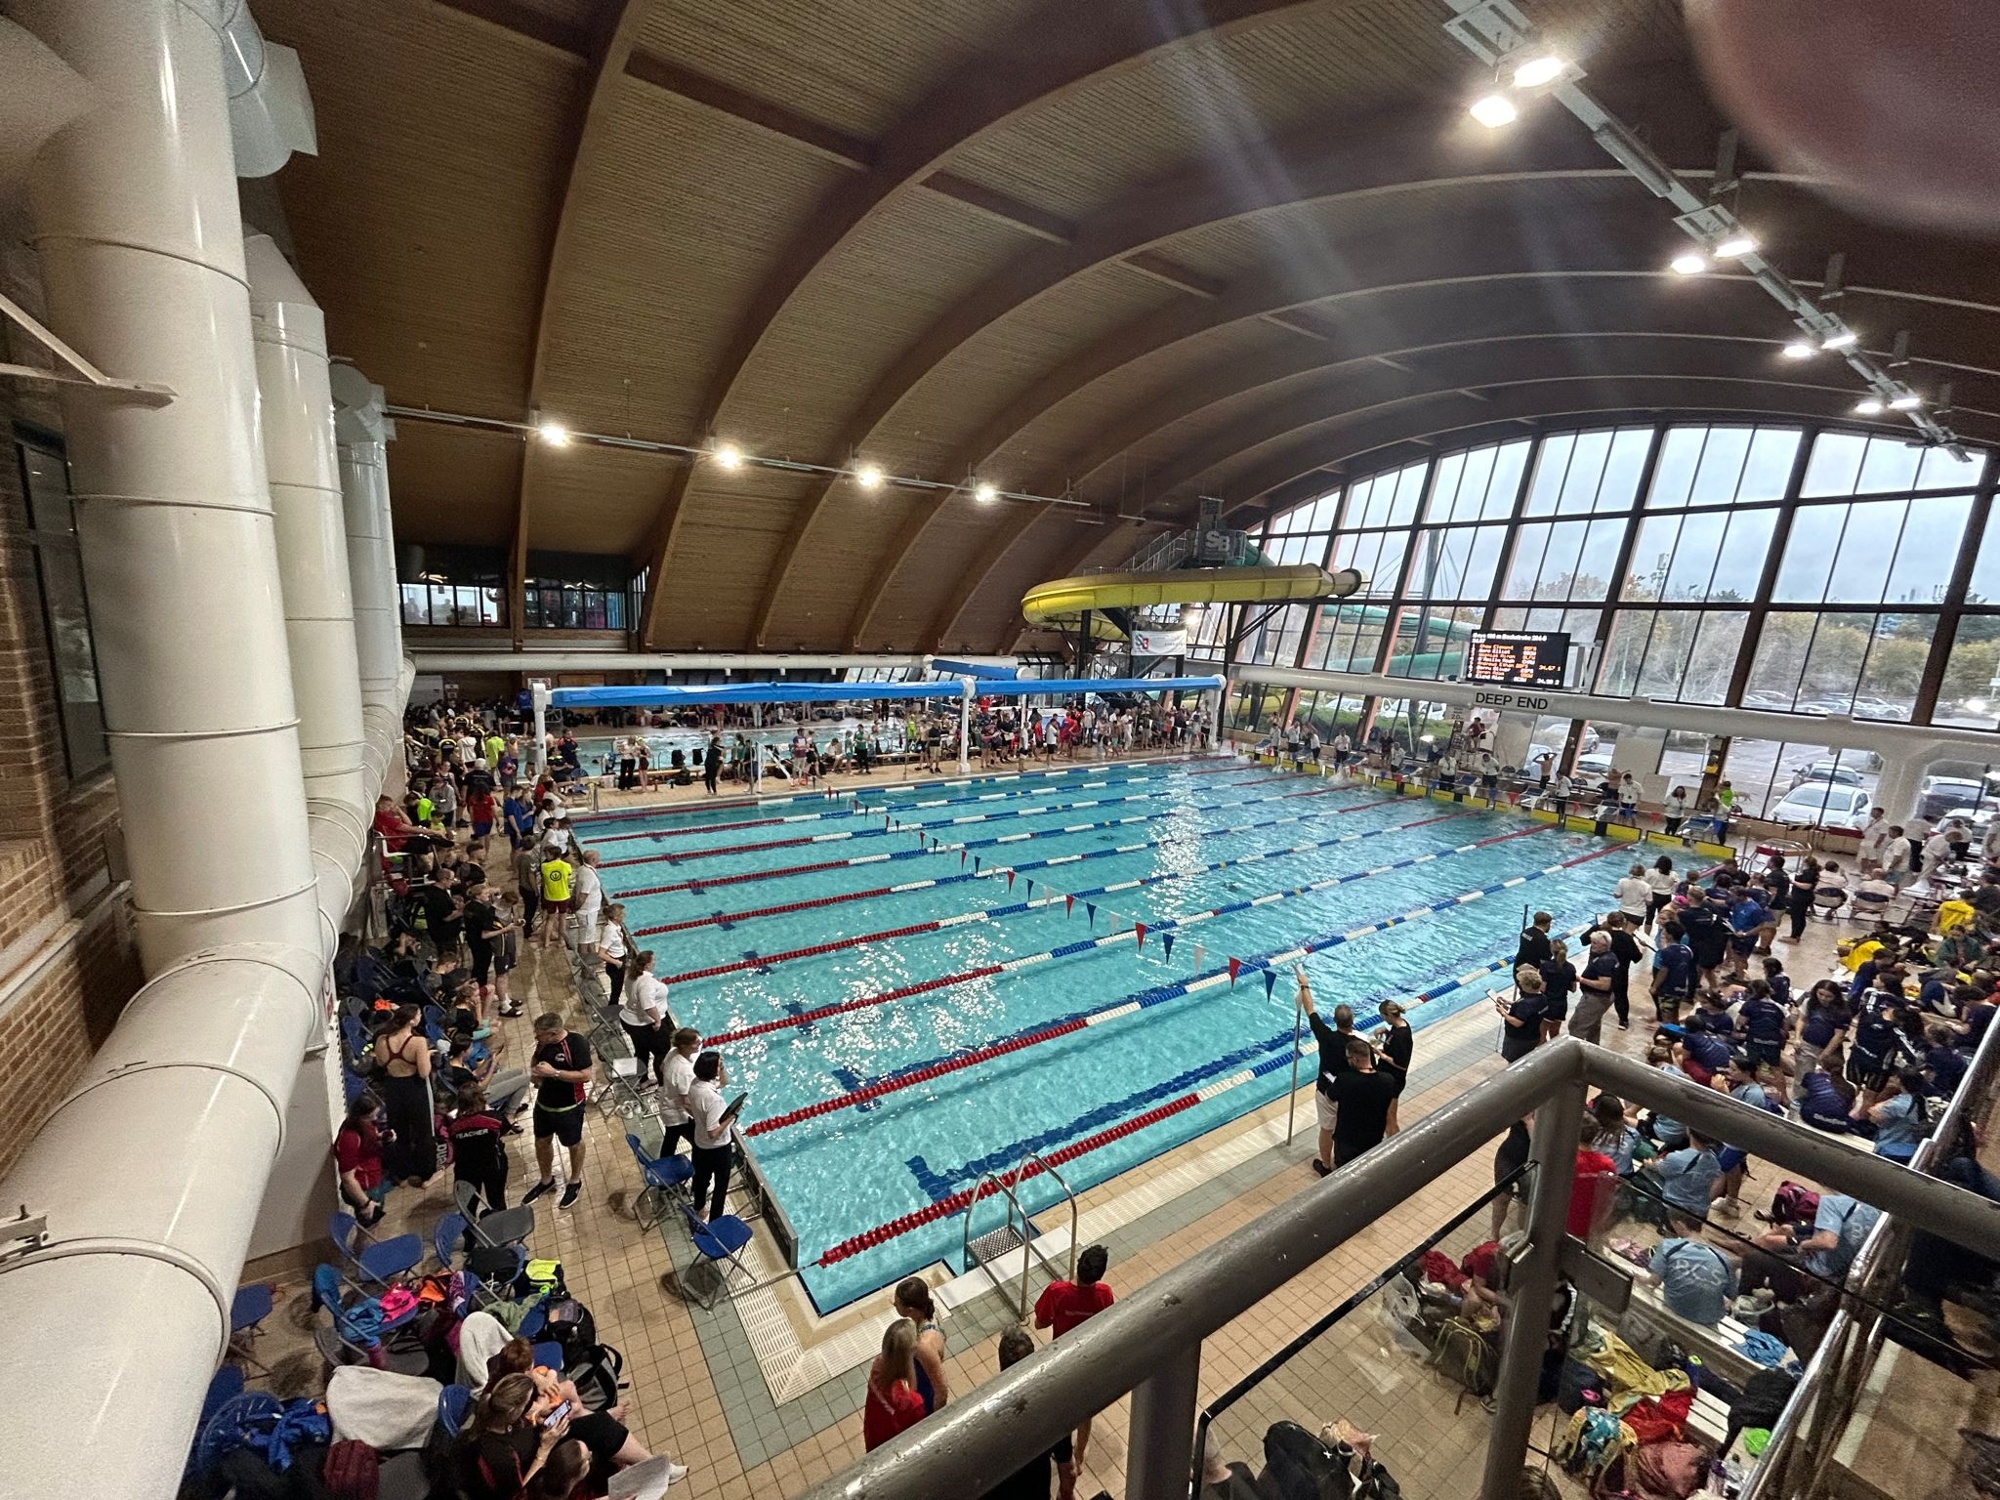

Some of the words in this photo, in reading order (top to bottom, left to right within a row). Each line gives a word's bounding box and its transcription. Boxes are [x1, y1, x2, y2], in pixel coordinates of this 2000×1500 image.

[1476, 692, 1512, 706] DEEP
[1517, 696, 1548, 710] END
[456, 1128, 488, 1139] TEACHER
